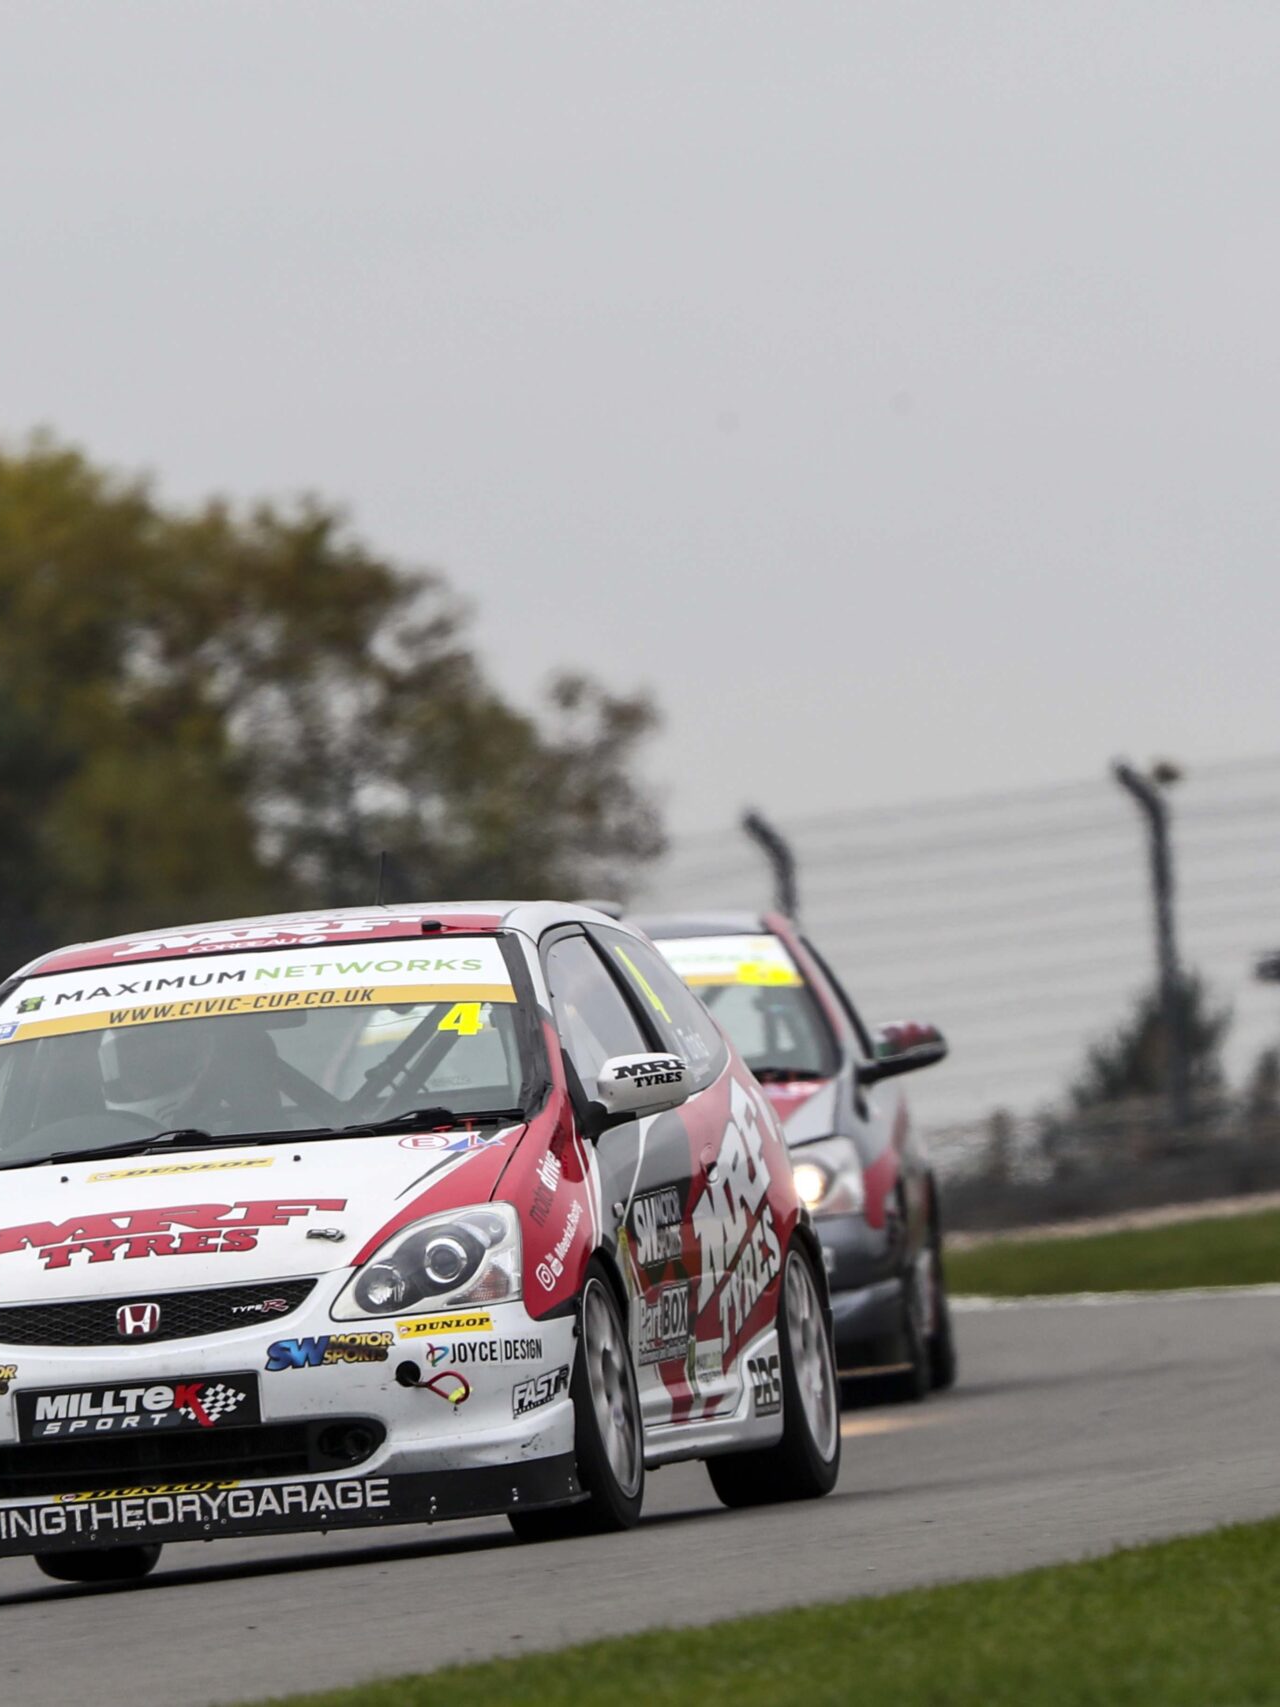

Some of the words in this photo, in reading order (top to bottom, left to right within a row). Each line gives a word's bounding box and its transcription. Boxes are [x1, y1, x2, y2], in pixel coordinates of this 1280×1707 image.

[55, 969, 247, 1005] MAXIMUM
[254, 958, 483, 982] NETWORKS
[108, 988, 376, 1025] WWW.CIVIC-CUP.CO.UK
[437, 1002, 484, 1036] 4
[612, 1059, 687, 1080] MRF
[633, 1071, 683, 1088] TYRES
[126, 1159, 268, 1176] DUNLOP
[692, 1076, 778, 1315] MRF
[38, 1228, 260, 1270] TYRES
[719, 1205, 782, 1357] TYRES
[231, 1304, 263, 1314] TYPE
[261, 1298, 290, 1313] R
[414, 1317, 491, 1333] DUNLOP
[328, 1331, 395, 1347] MOTOR
[449, 1340, 498, 1364] JOYCE
[504, 1338, 543, 1361] DESIGN
[265, 1335, 331, 1372] SW
[322, 1347, 389, 1364] SPORTS
[42, 1412, 168, 1436] SPORT
